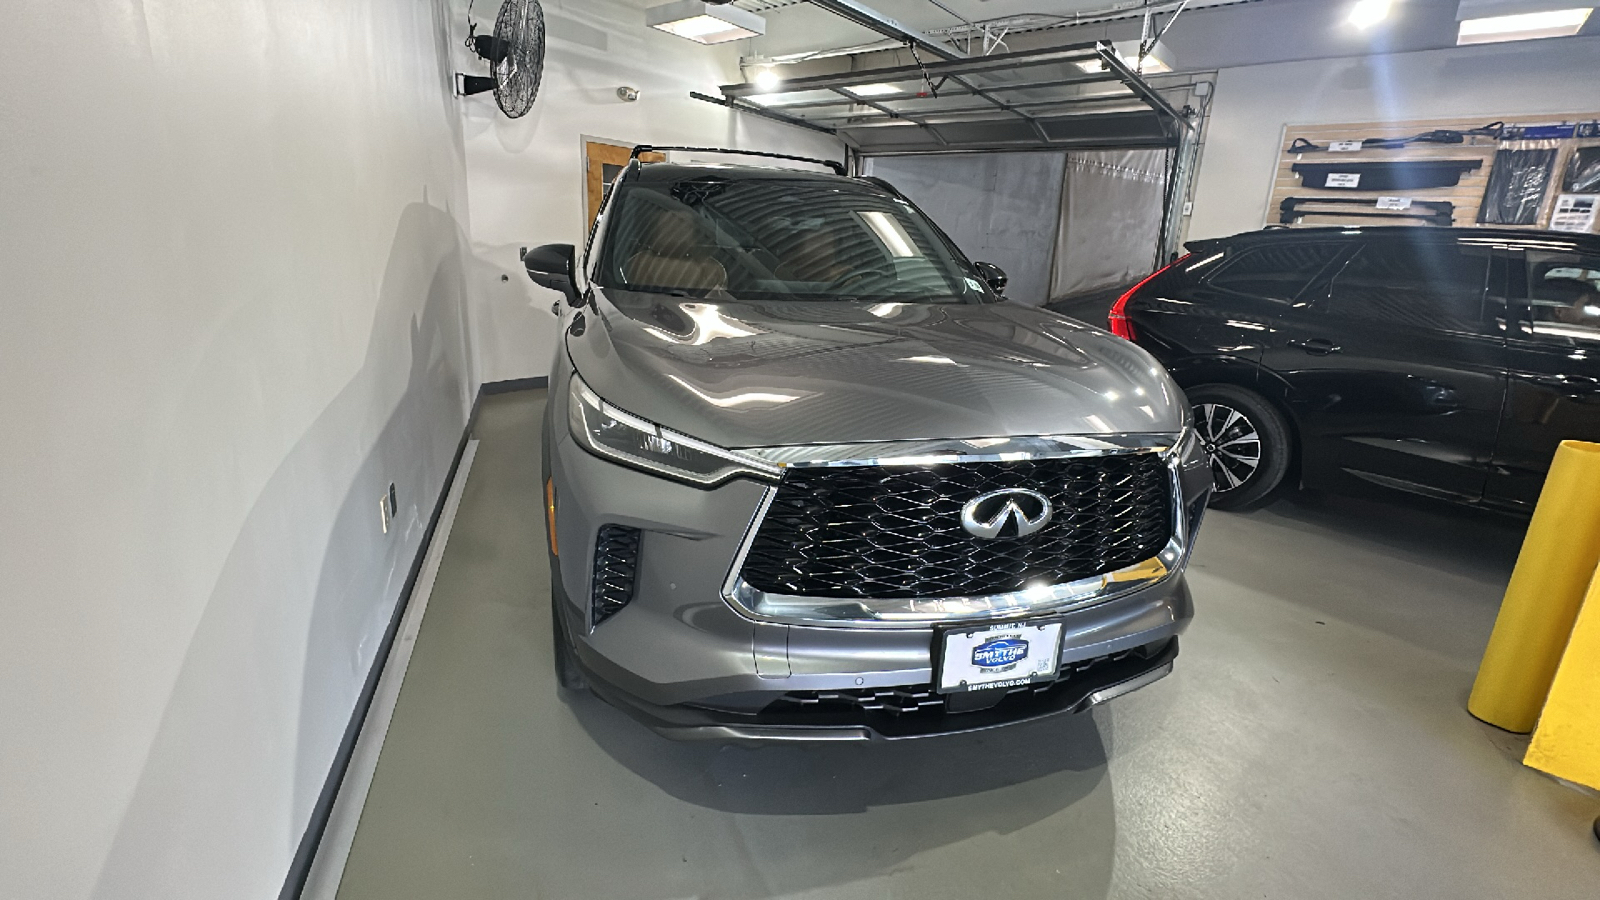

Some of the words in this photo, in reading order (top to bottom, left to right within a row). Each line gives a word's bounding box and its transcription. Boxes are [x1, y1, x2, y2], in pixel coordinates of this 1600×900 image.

[974, 648, 1024, 660] SMYTHE
[986, 655, 1016, 664] VOLVO
[968, 678, 1031, 691] SMYTHEVOLVO.COM
